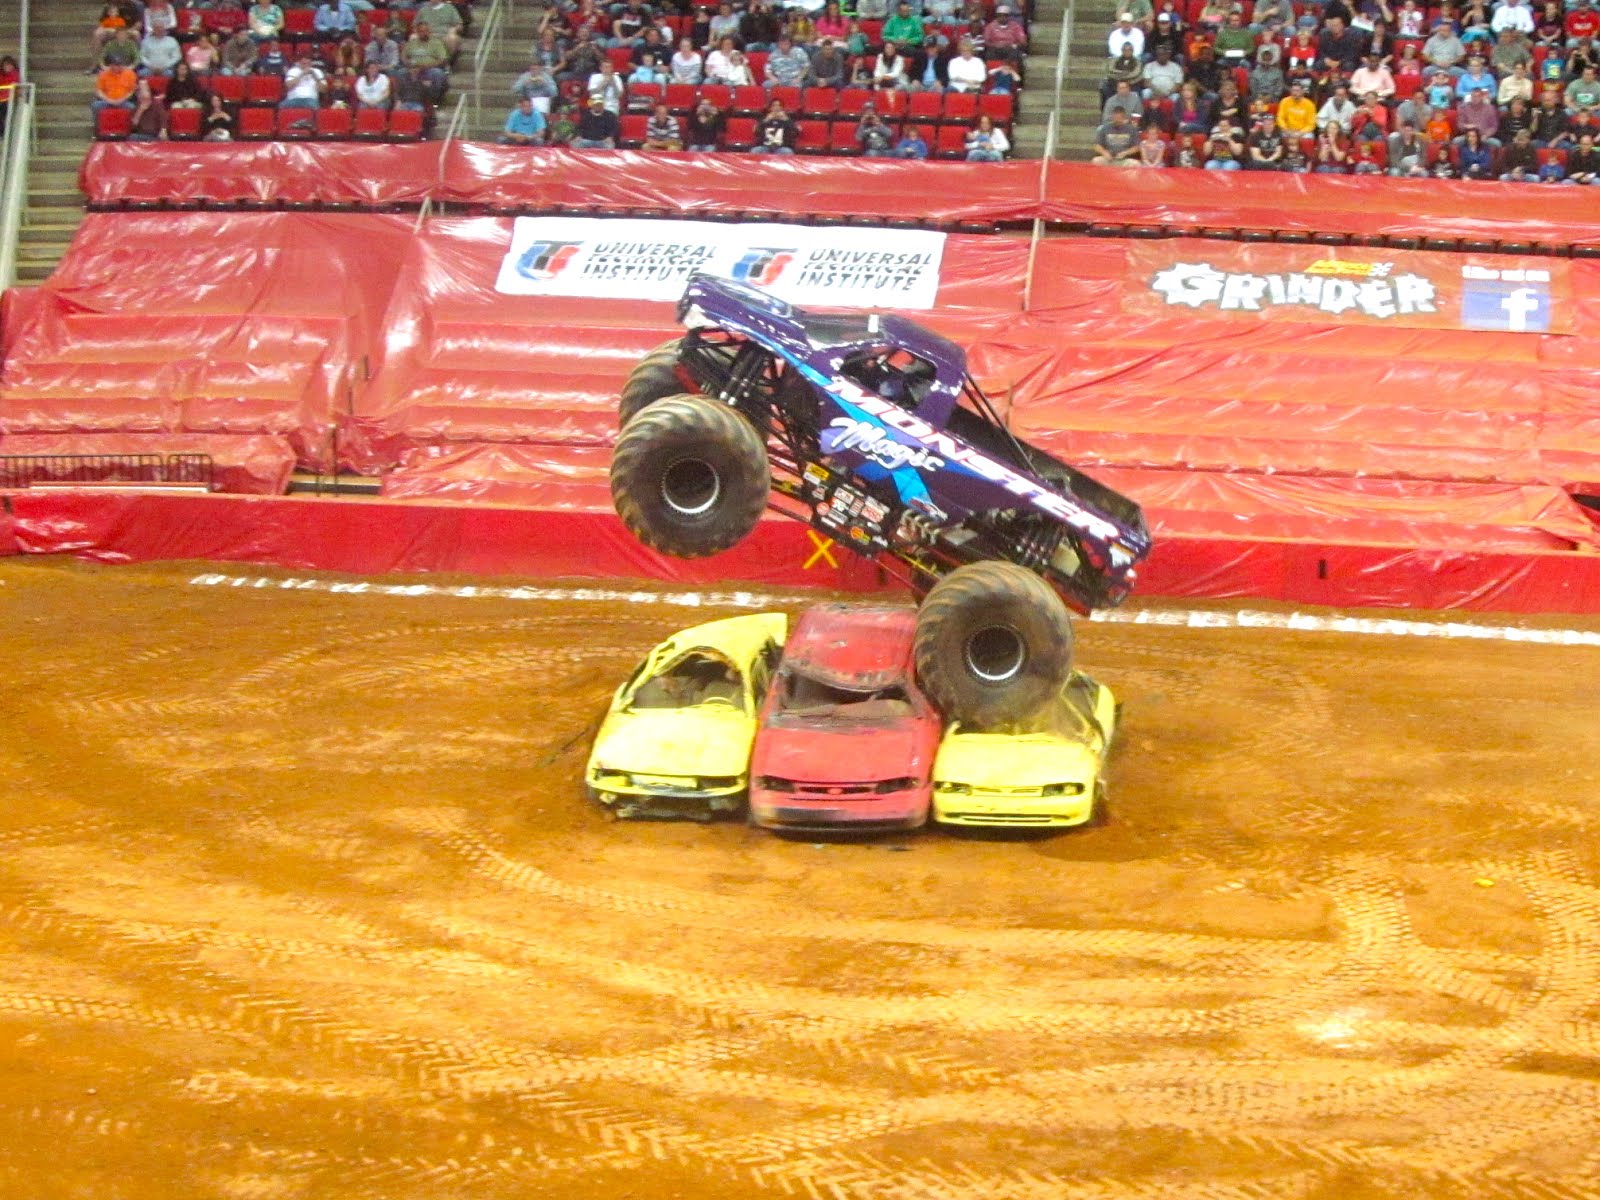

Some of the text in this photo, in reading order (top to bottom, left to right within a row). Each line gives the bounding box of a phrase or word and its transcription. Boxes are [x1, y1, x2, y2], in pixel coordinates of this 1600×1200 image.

[594, 242, 717, 258] UNIVERSAL
[809, 249, 932, 265] UNIVERSAL
[581, 264, 700, 281] INSTITUTE
[796, 271, 917, 290] INSTITUTE
[1152, 262, 1438, 318] GRINDER
[829, 416, 945, 472] Magic
